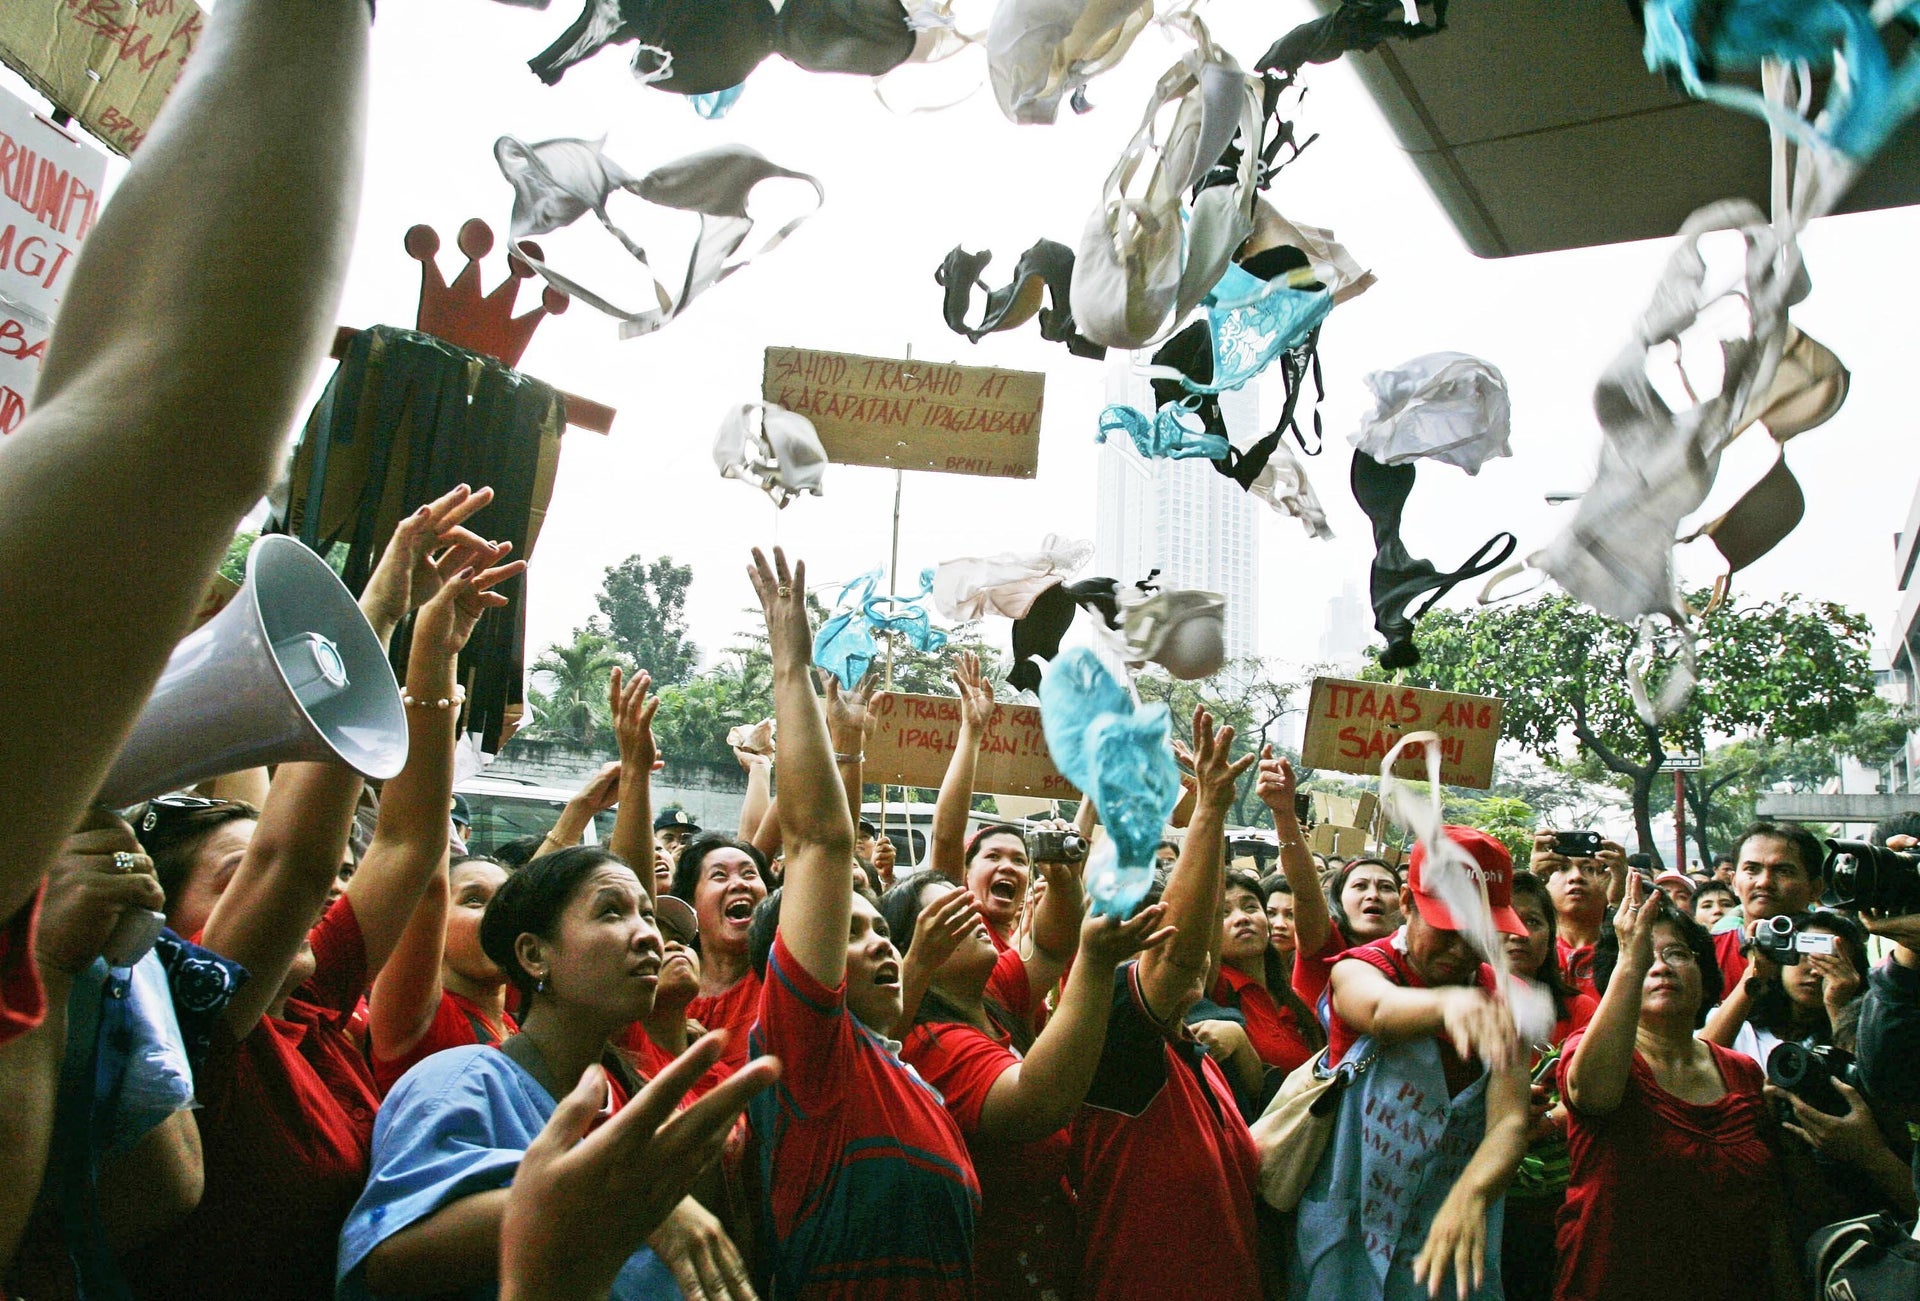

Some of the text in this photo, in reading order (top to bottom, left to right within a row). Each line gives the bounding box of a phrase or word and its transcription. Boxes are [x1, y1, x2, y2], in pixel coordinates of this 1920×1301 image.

[862, 360, 962, 395] TRABAHO
[977, 372, 1017, 399] AT
[1324, 684, 1491, 729] ITAAS ANG
